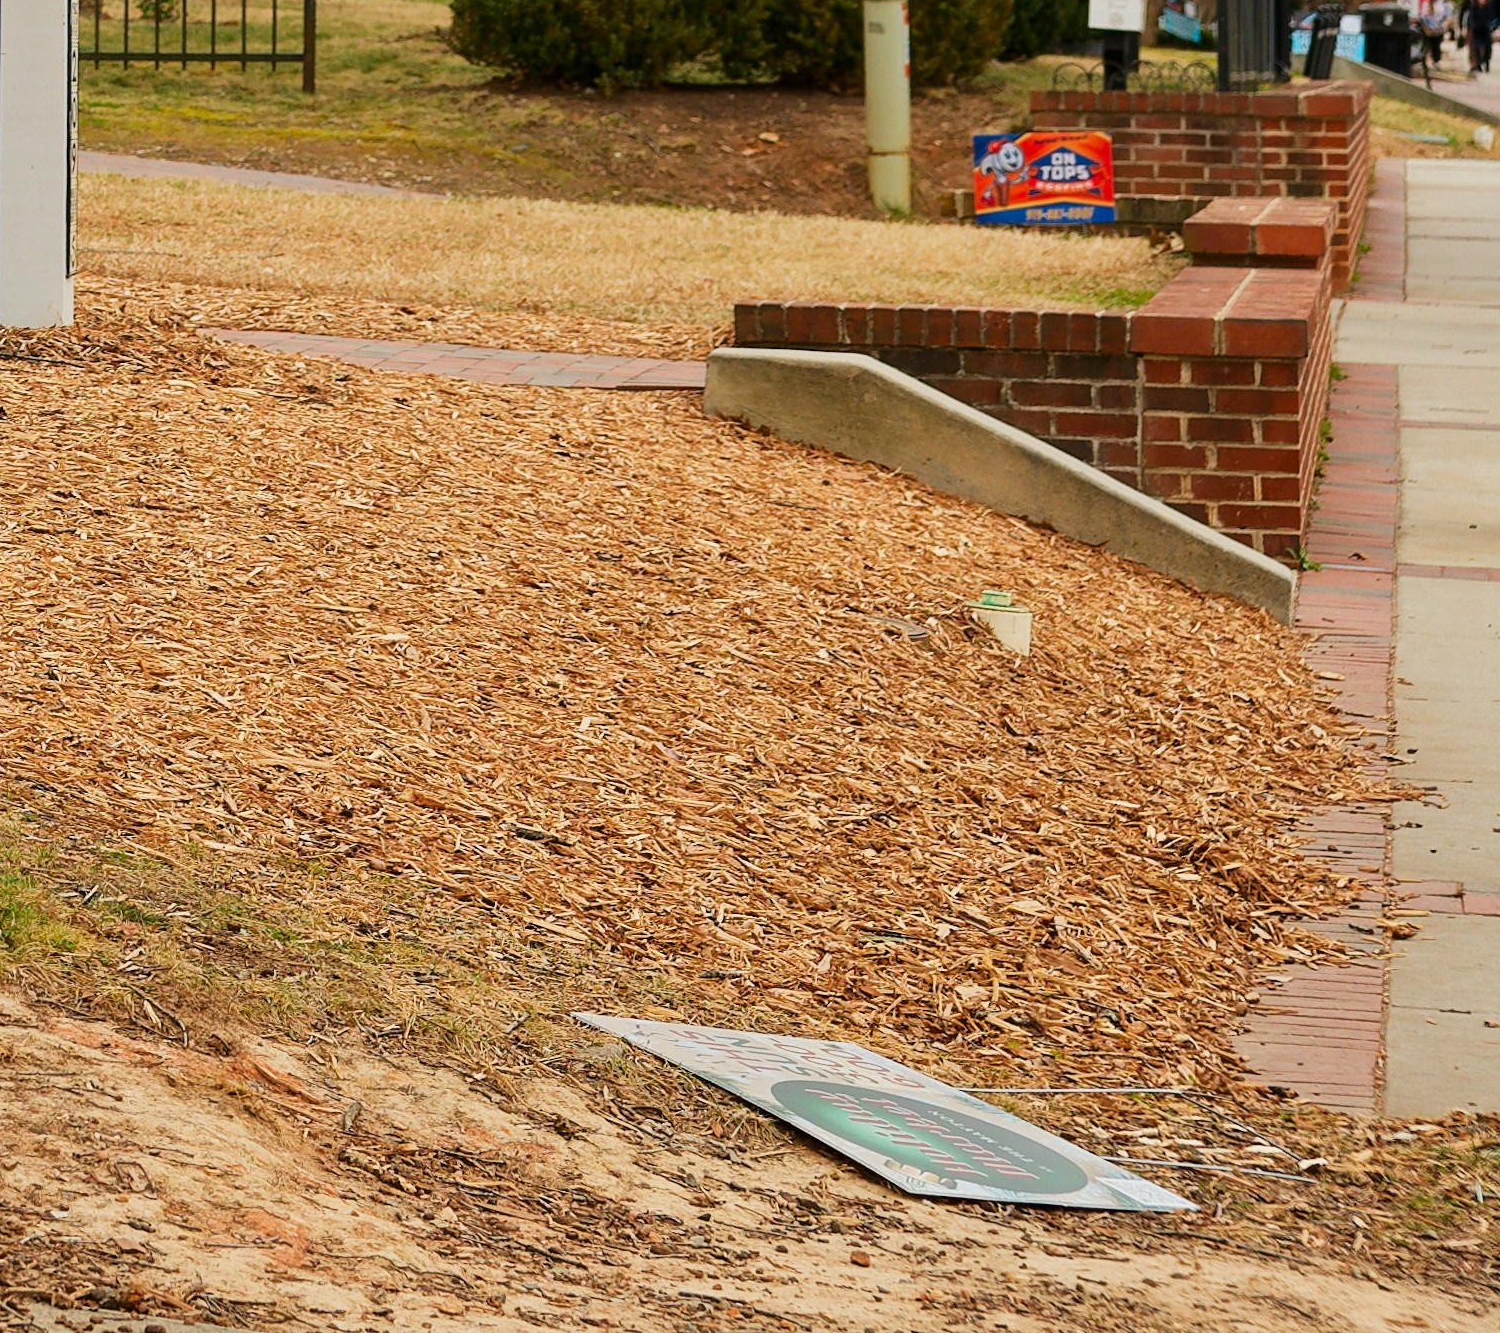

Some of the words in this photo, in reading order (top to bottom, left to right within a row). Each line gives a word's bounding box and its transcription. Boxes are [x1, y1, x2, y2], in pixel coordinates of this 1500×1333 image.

[1040, 165, 1090, 181] TOPS
[1051, 152, 1076, 166] ON
[804, 1088, 989, 1178] Holiday
[861, 1096, 1040, 1180] Market
